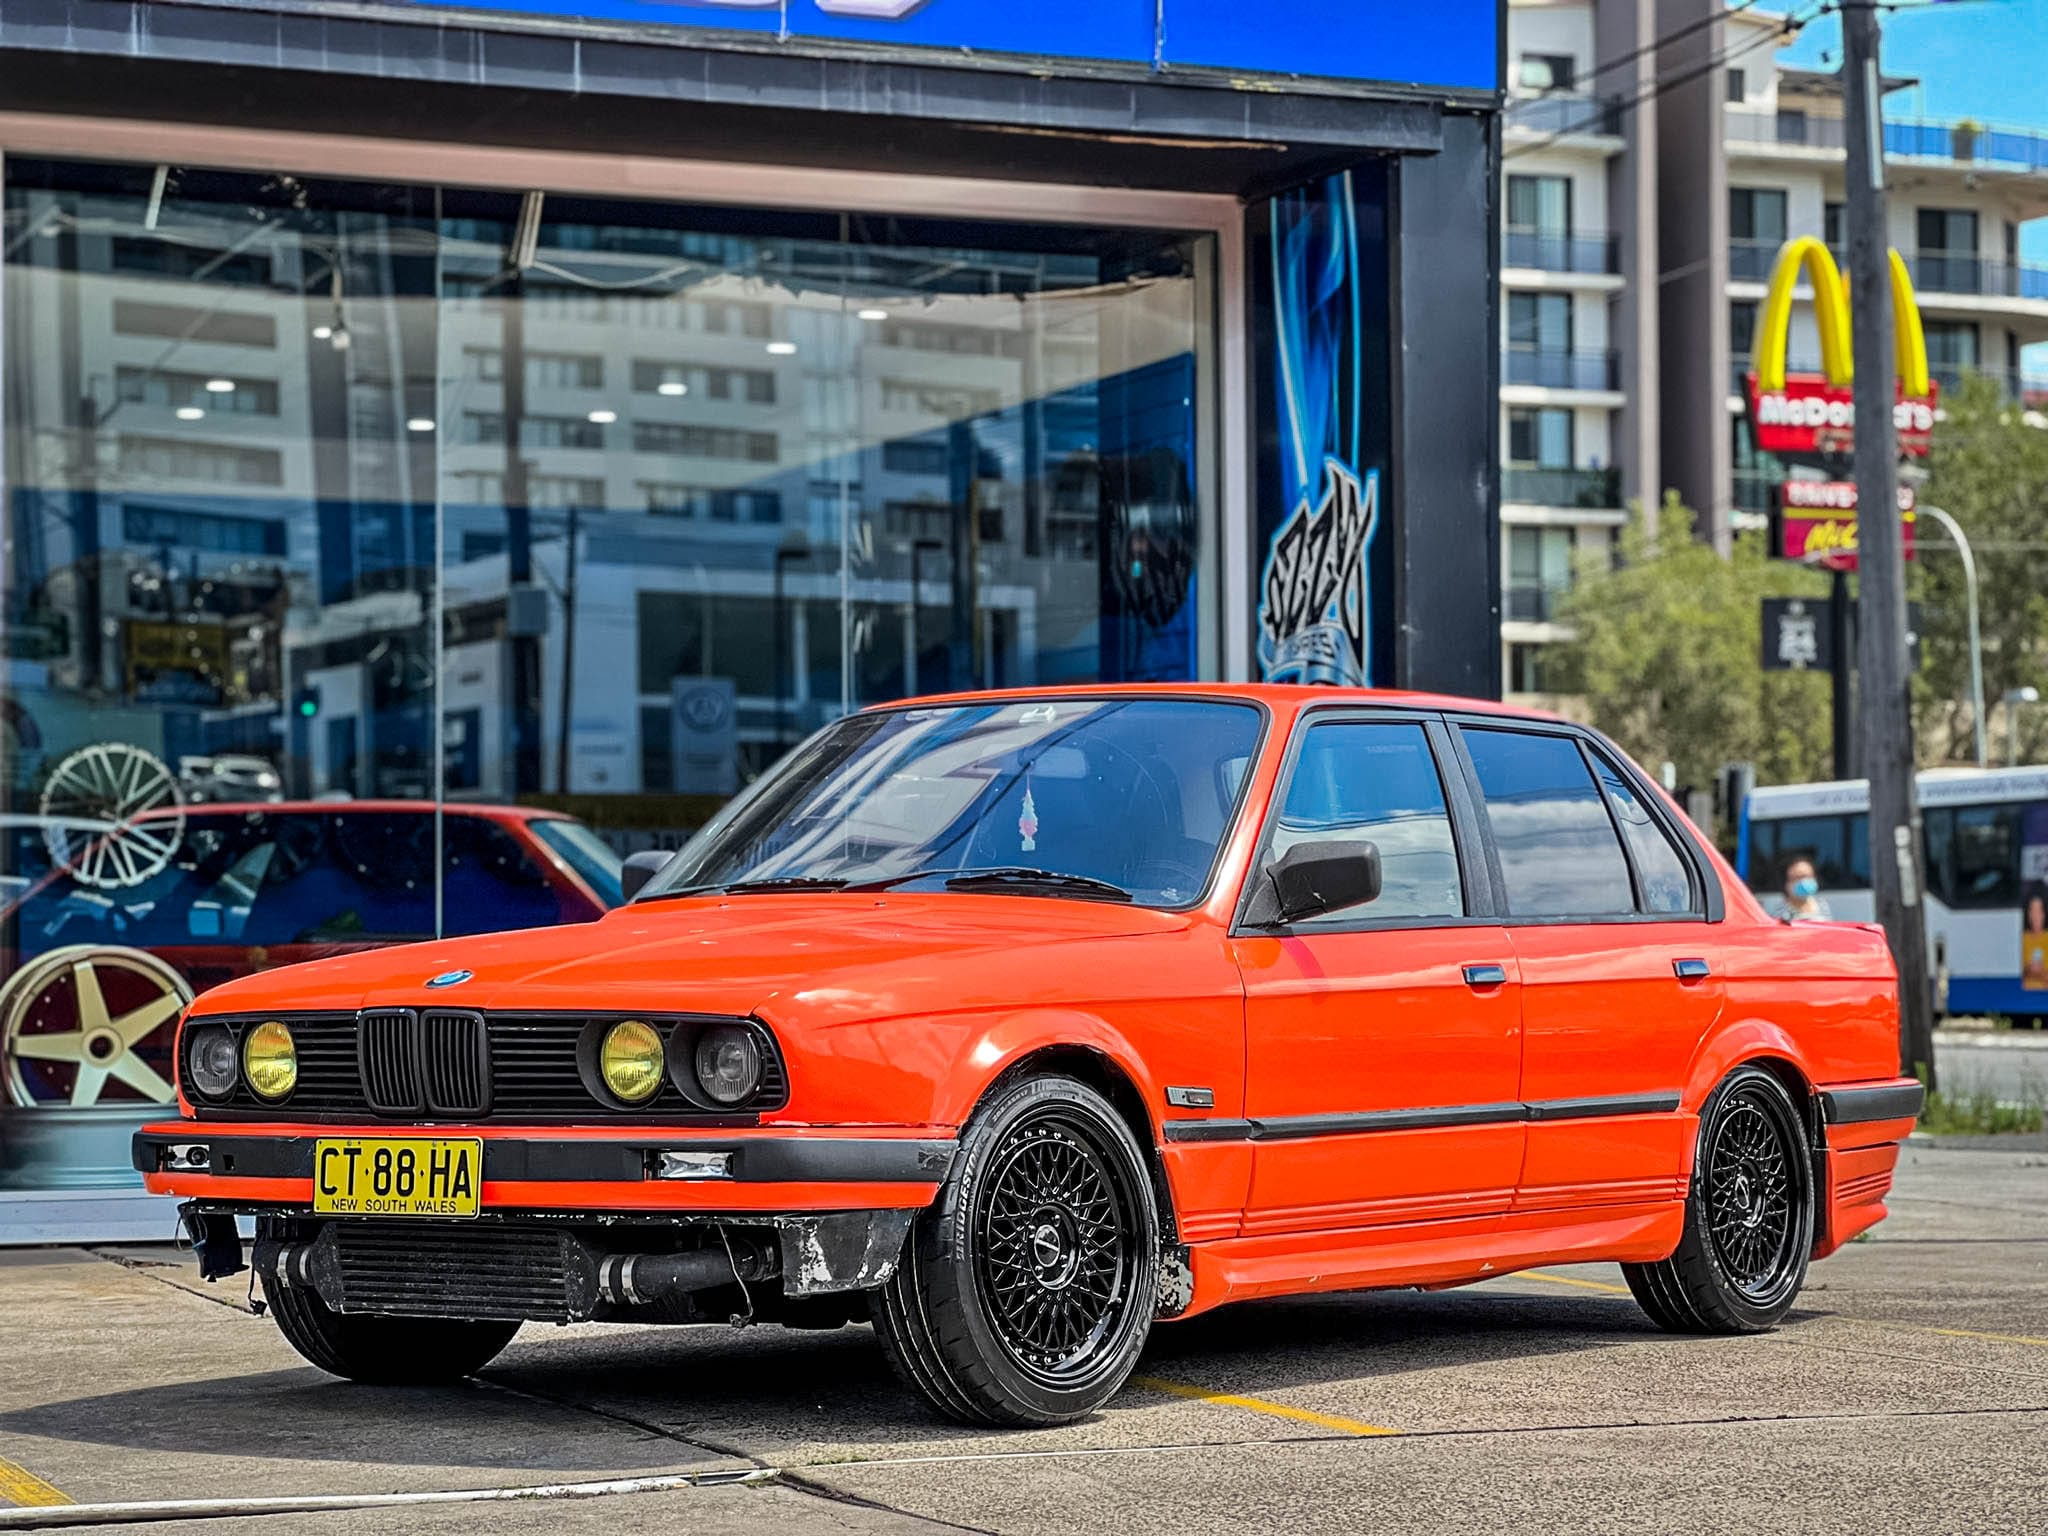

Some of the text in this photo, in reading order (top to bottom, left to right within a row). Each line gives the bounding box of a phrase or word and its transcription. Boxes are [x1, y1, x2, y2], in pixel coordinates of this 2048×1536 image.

[1758, 395, 1934, 431] McDod's
[331, 1198, 457, 1213] NEW SOUTH WALES
[955, 1133, 992, 1262] BRIDGESTONE
